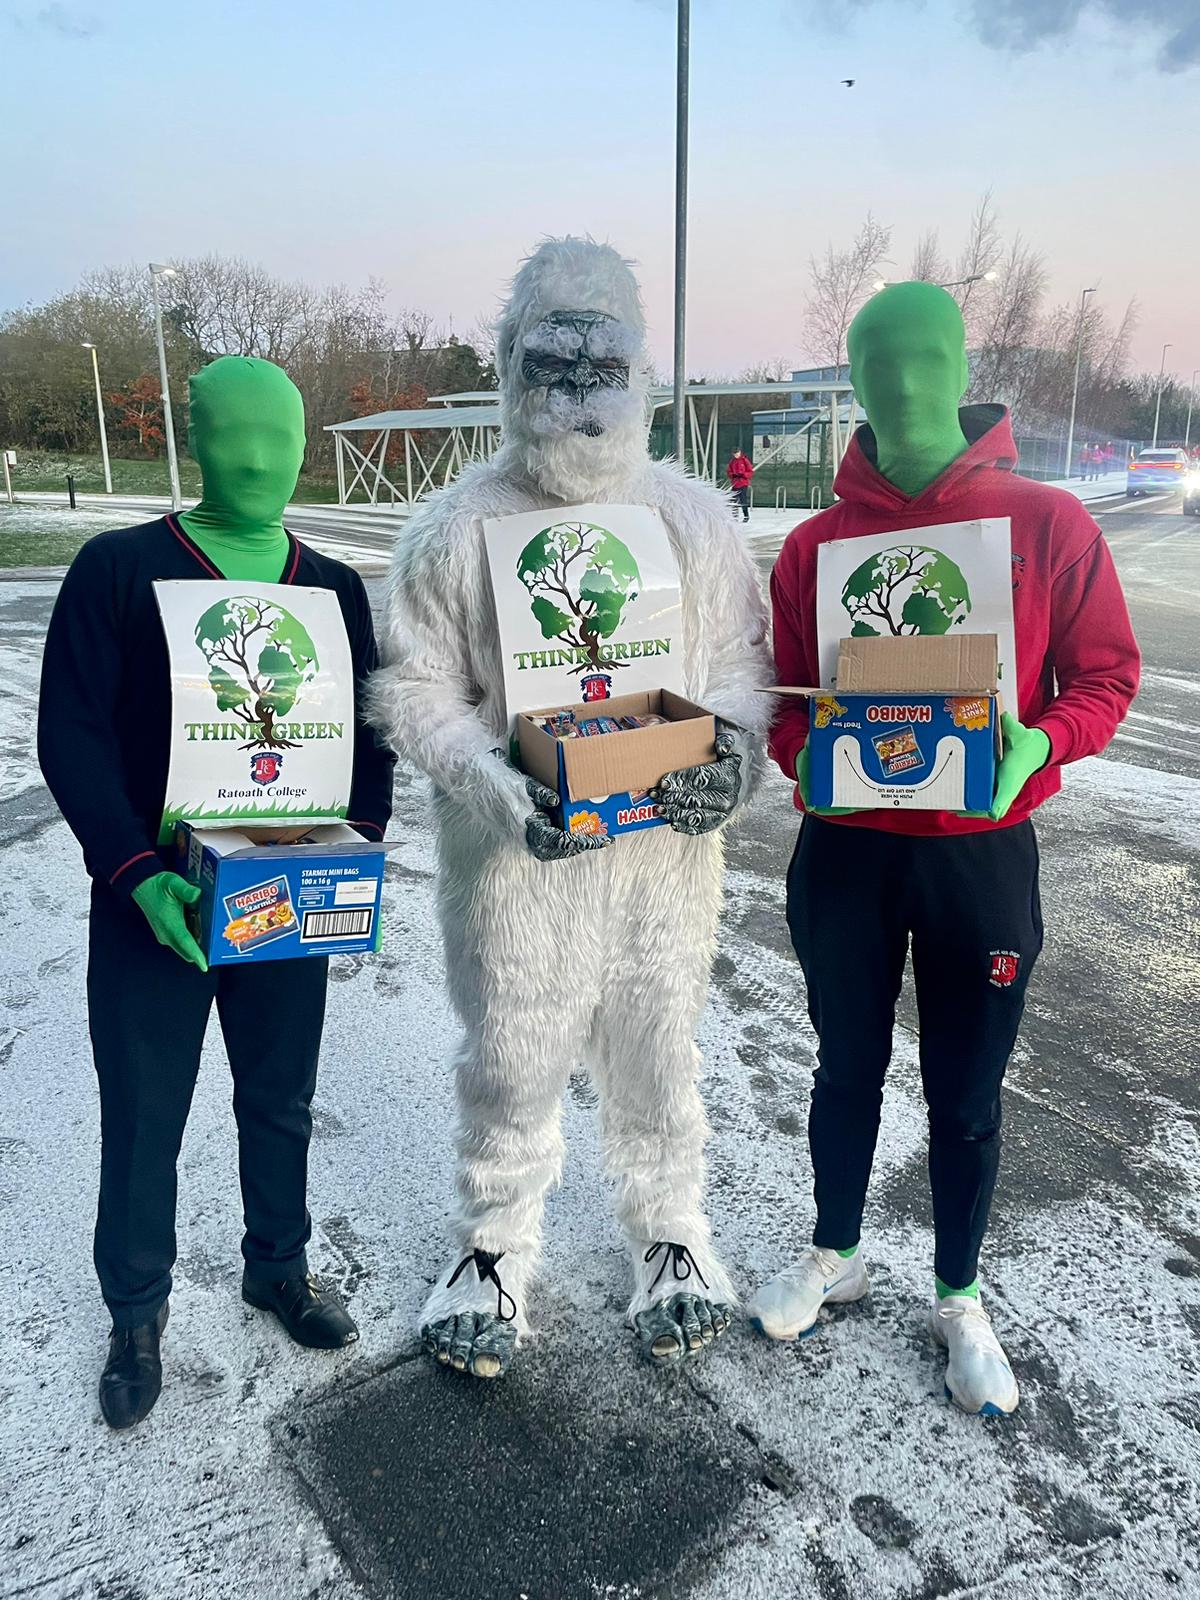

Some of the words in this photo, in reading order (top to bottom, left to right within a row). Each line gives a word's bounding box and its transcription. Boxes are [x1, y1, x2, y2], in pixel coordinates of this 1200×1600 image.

[513, 645, 592, 669] THINK
[598, 638, 672, 662] GREEN
[868, 705, 931, 722] HARIBO
[960, 701, 982, 713] JUICE
[963, 707, 984, 719] FRUIT
[184, 723, 265, 741] THINK
[271, 722, 344, 740] GREEN
[889, 756, 917, 772] HARIBO
[218, 788, 262, 798] Ratoath
[267, 787, 307, 798] College
[618, 804, 660, 825] HARIB
[235, 885, 278, 909] HARIBO
[244, 896, 277, 913] Starmix
